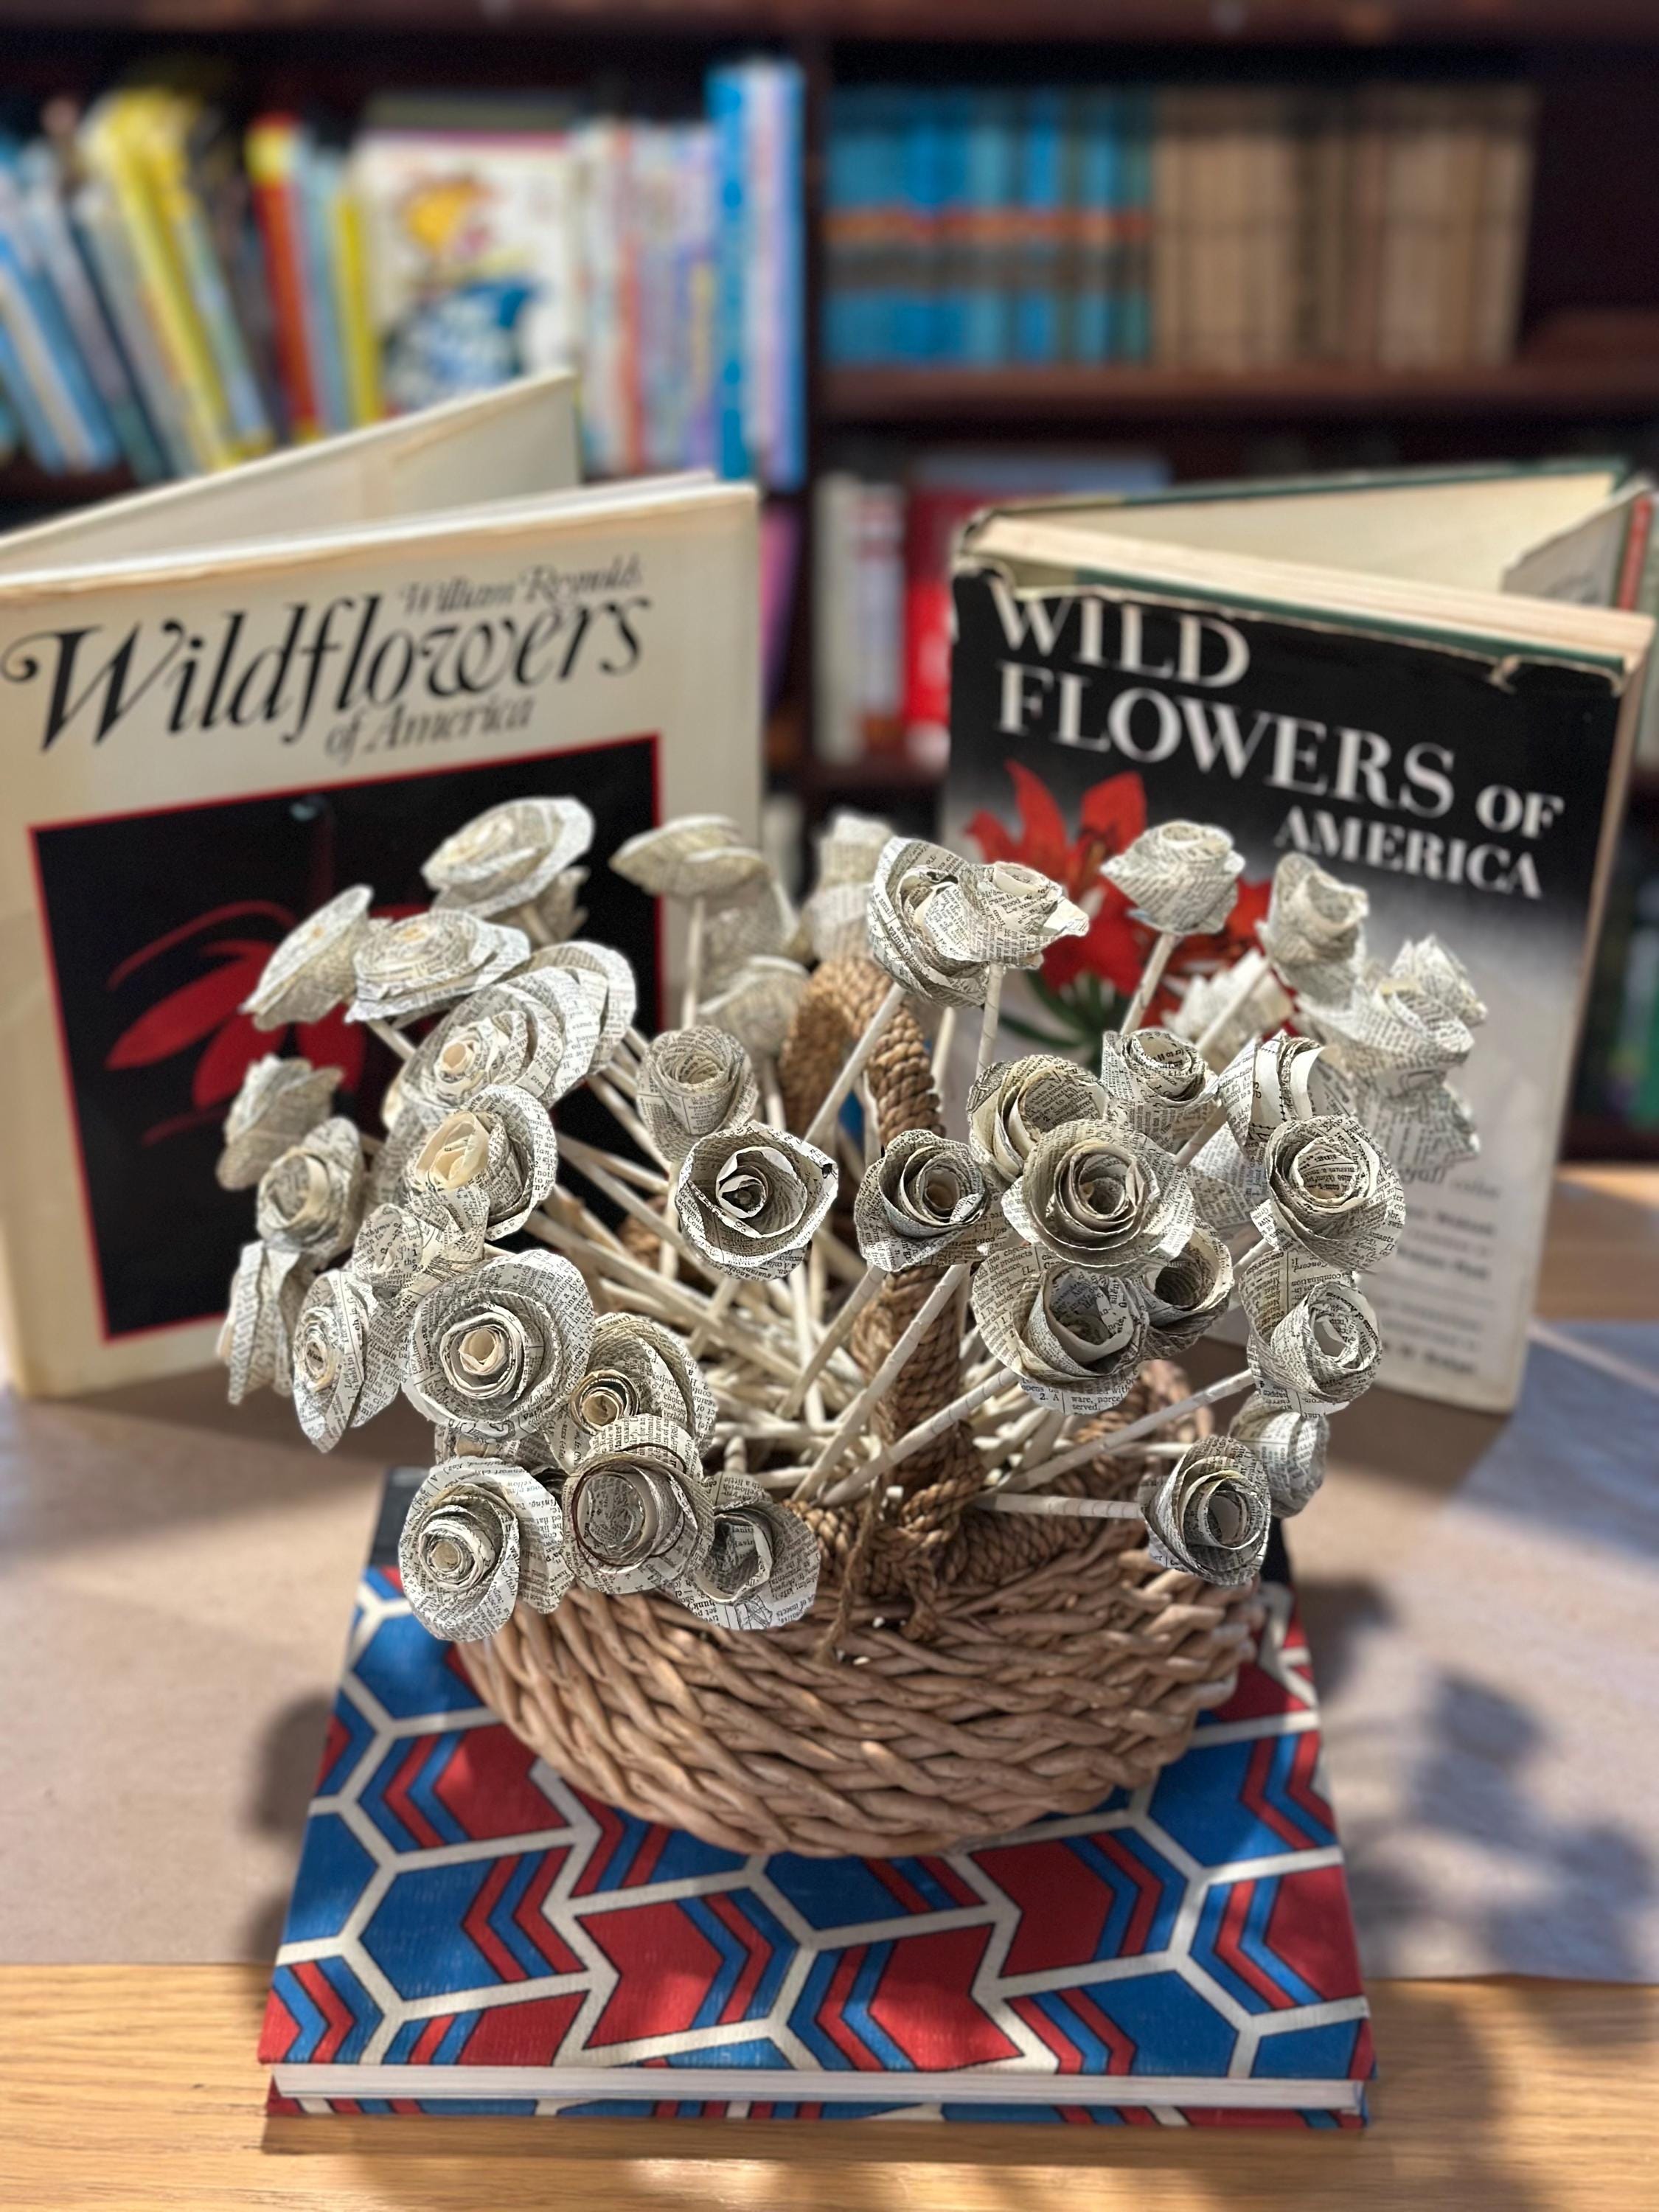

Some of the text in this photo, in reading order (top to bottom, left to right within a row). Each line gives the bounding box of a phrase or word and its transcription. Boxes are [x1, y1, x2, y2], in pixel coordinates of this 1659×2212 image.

[1, 594, 650, 754] Wildflowers
[988, 577, 1251, 689] WILD
[994, 661, 1565, 839] FLOWERS OF
[1273, 804, 1543, 900] AMERICA
